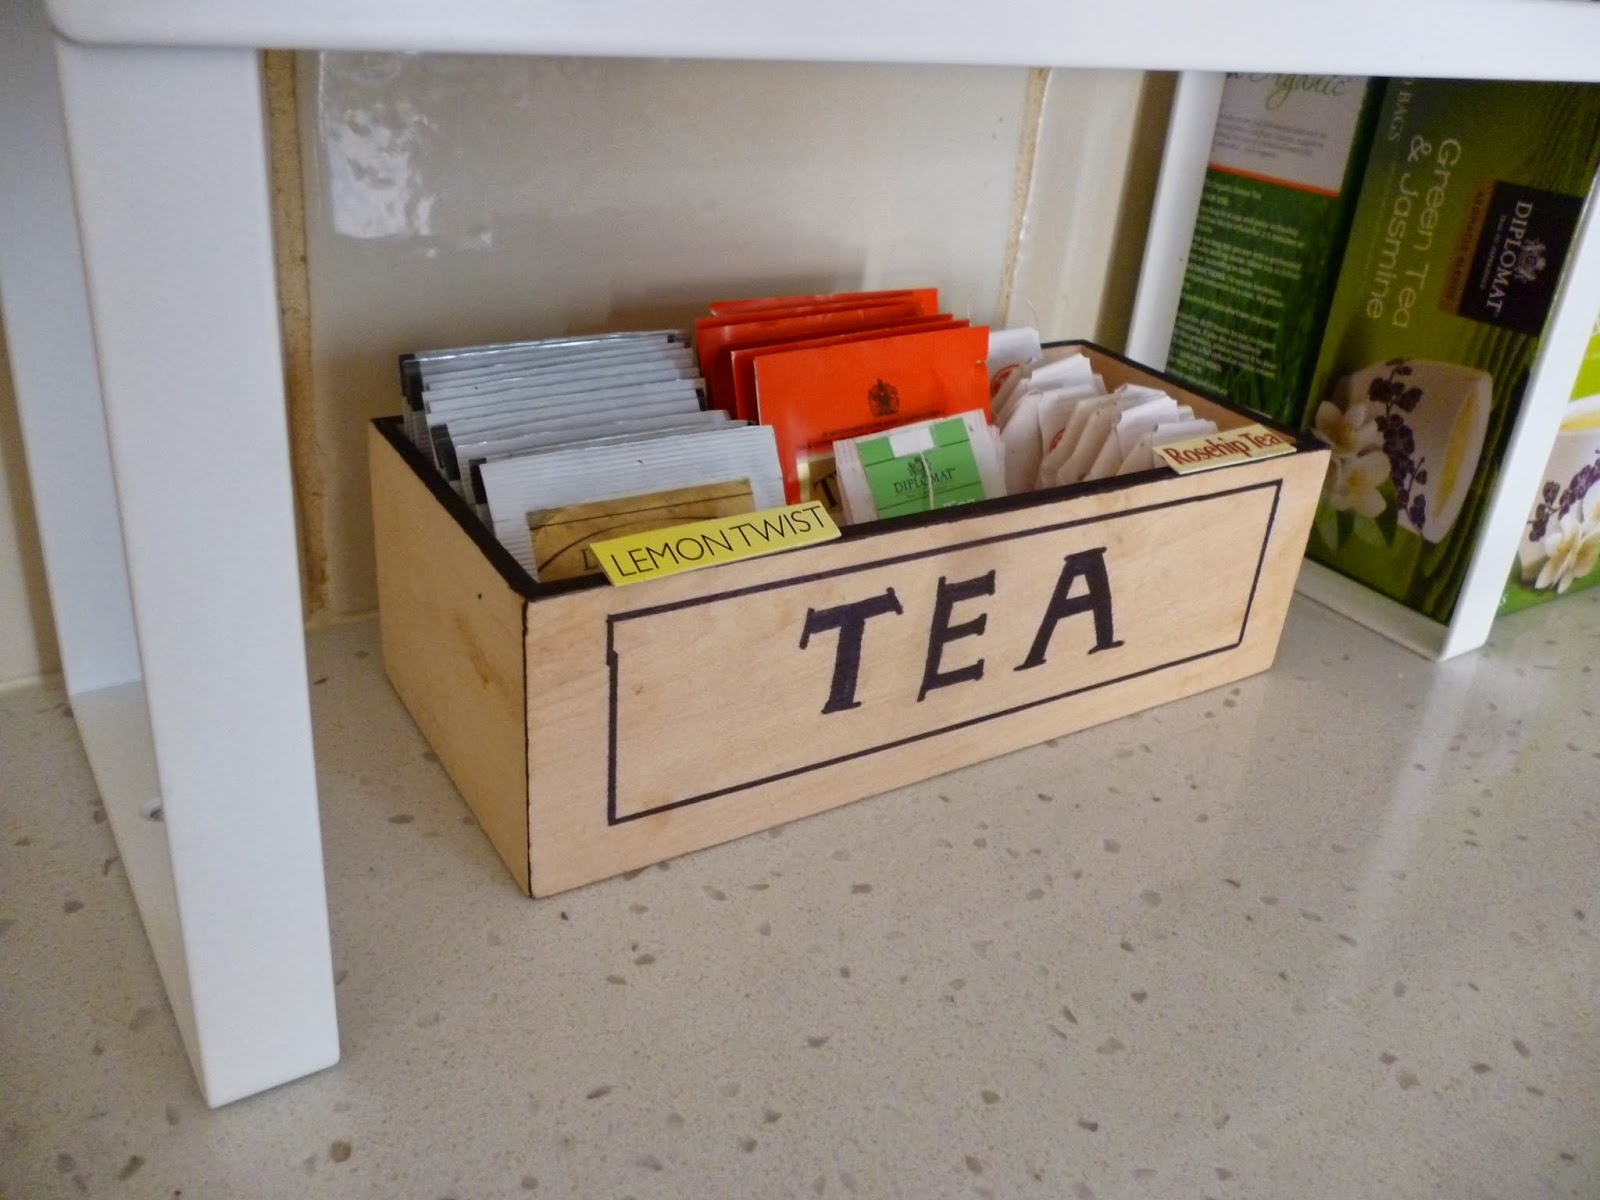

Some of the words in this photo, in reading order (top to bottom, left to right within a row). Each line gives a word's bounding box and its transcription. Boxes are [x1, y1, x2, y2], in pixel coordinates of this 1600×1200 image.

[1407, 135, 1432, 162] &
[1414, 138, 1461, 250] Green
[1367, 172, 1419, 319] Jasmine
[1486, 200, 1534, 313] DIPLOMAT
[1392, 263, 1429, 328] Tea
[1162, 437, 1252, 465] Rosehip
[1238, 433, 1284, 449] Tea
[611, 529, 734, 577] LEMON
[728, 505, 825, 548] TWIST
[799, 546, 1125, 714] TEA
